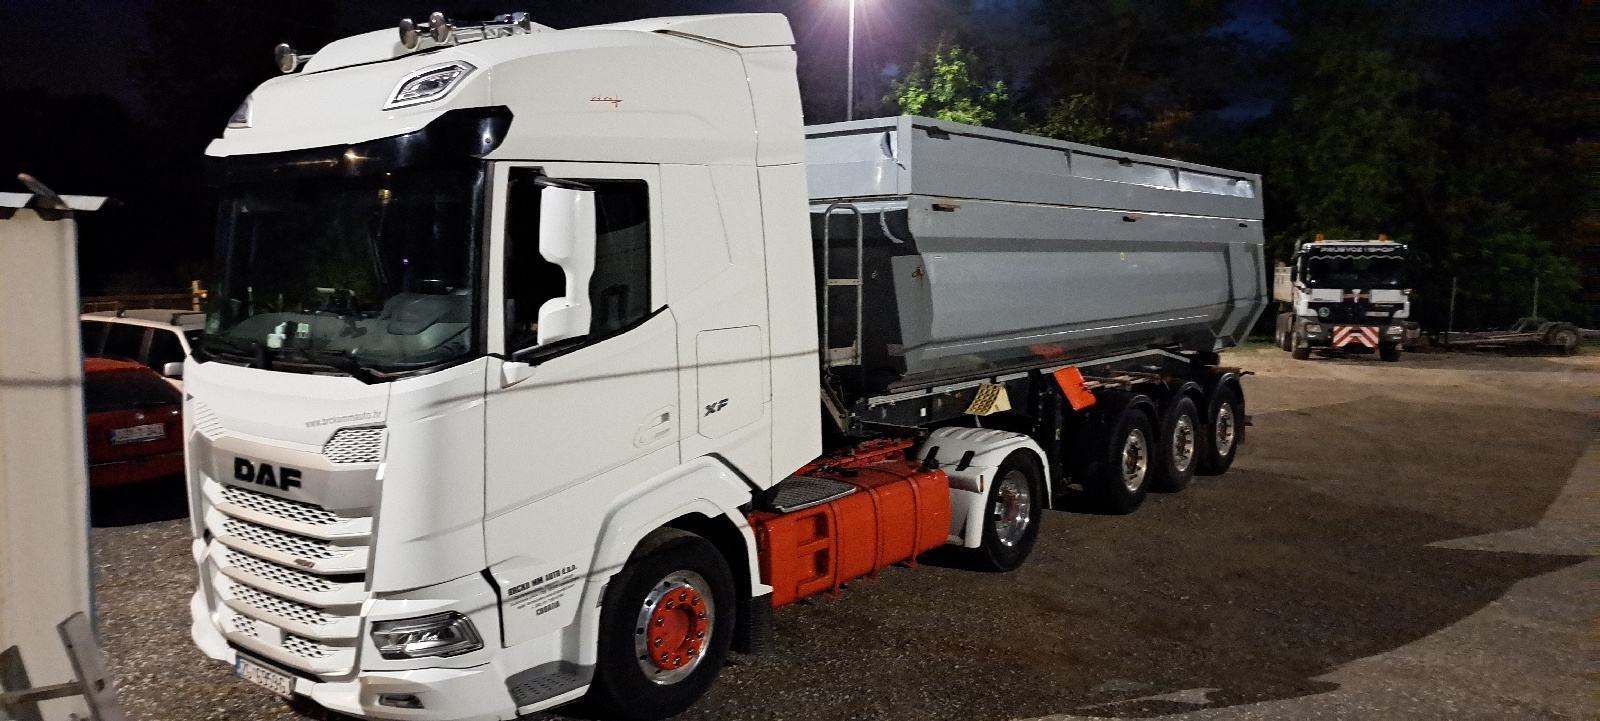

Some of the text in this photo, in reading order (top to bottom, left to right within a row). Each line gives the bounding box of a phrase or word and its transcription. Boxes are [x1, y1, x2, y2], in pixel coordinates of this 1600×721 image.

[704, 398, 729, 417] XF
[234, 456, 302, 492] DAF
[536, 600, 560, 615] CROATIA
